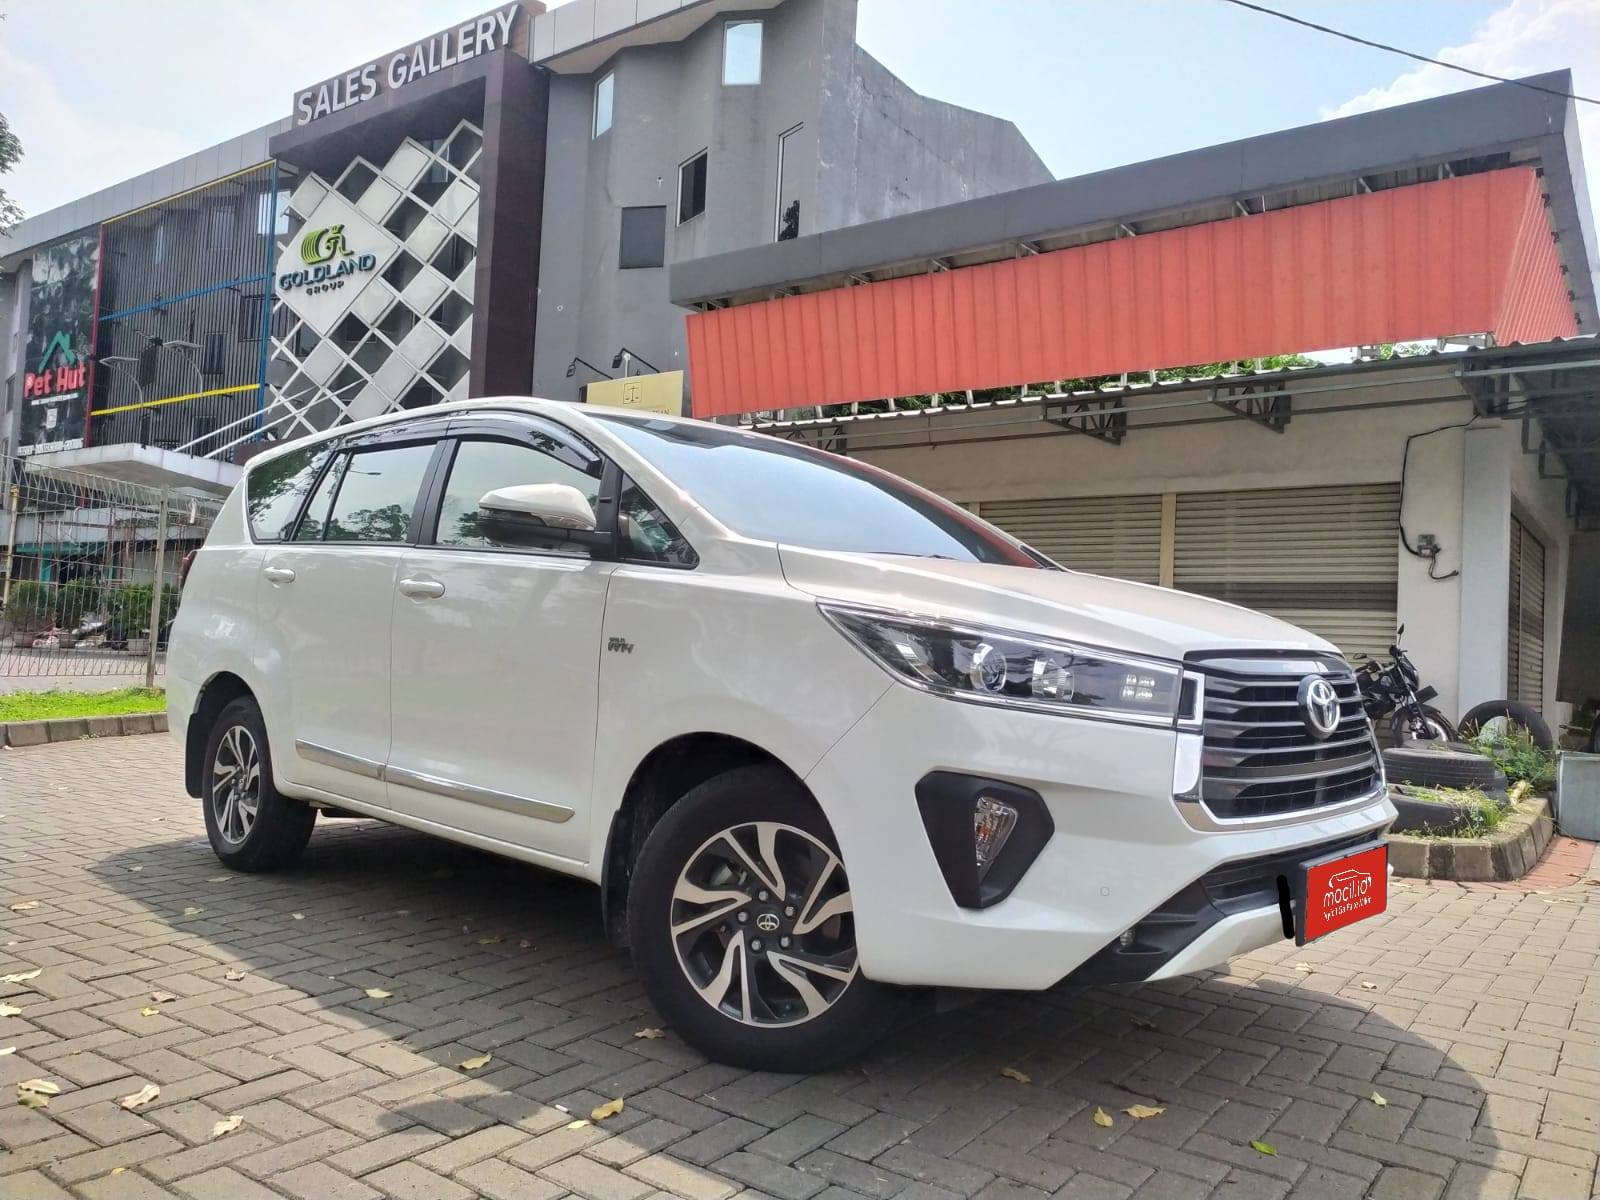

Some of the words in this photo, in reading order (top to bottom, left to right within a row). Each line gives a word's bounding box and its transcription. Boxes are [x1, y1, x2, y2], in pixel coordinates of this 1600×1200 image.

[297, 64, 378, 126] SALES
[387, 4, 519, 89] GALLERY
[279, 253, 376, 290] GOLDLAND
[306, 280, 345, 296] GROUP
[24, 369, 52, 397] Pet
[57, 363, 86, 391] Hut
